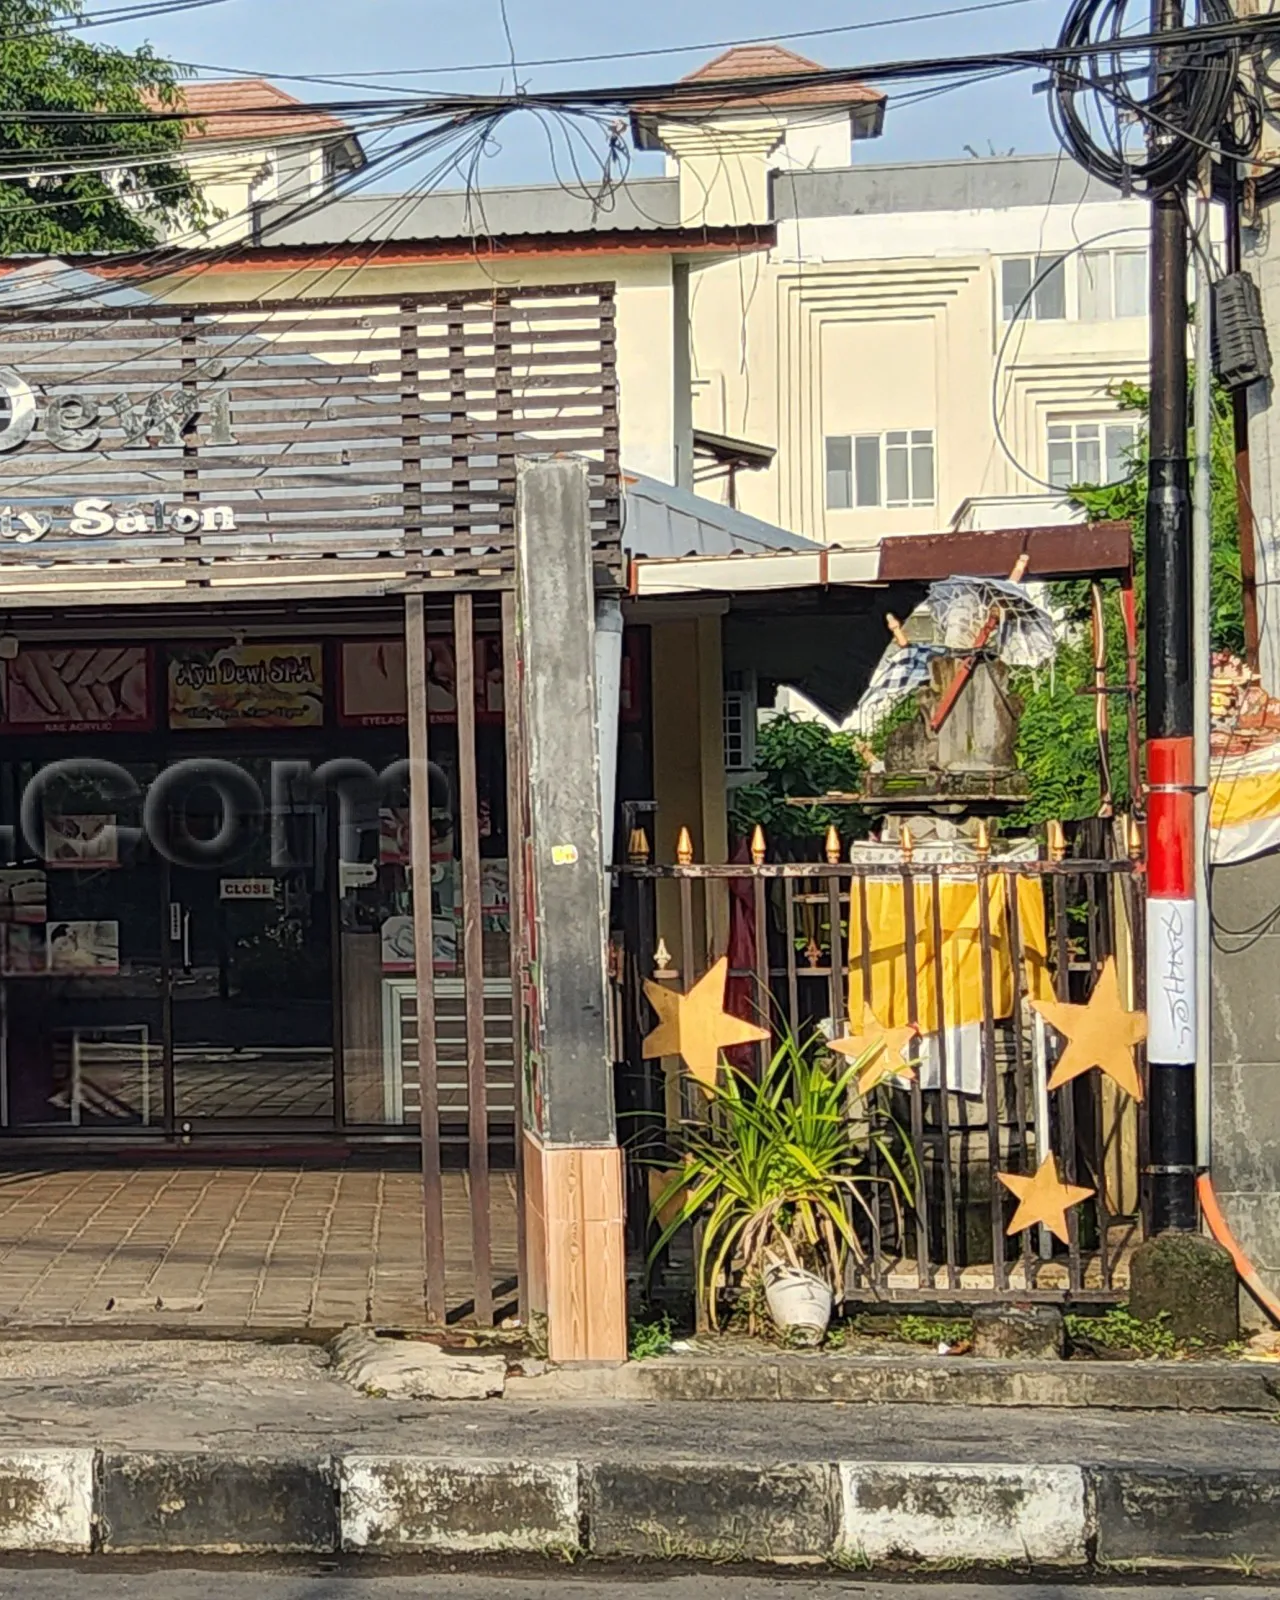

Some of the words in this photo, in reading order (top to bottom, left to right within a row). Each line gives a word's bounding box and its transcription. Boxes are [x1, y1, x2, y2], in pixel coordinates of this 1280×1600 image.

[69, 498, 238, 536] Salon
[176, 661, 217, 690] Ayu
[220, 658, 266, 685] Dewi
[270, 656, 315, 683] SPA
[68, 722, 113, 732] ACRYLIC
[225, 884, 270, 894] CLOSE
